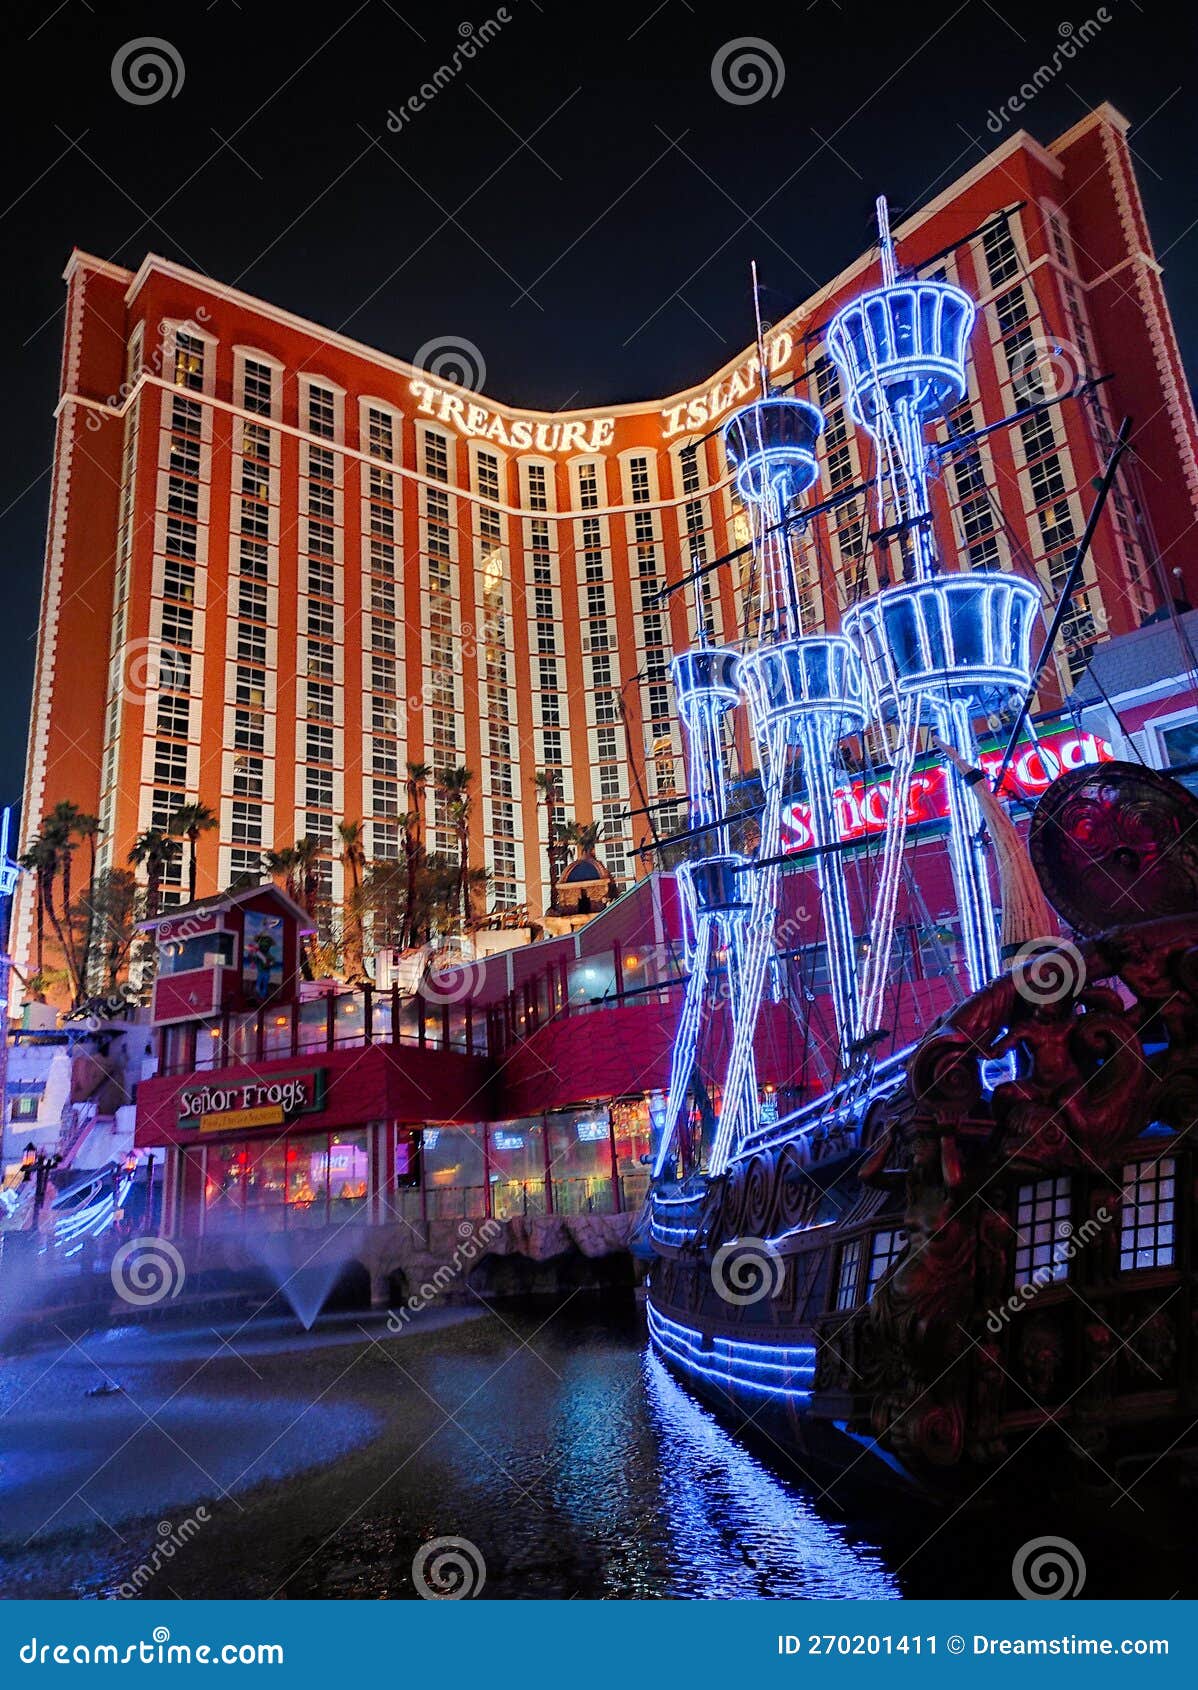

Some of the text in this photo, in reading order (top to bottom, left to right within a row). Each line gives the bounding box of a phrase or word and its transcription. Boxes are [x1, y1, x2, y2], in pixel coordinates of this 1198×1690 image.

[409, 332, 793, 452] TREASURE ISLAND
[781, 778, 931, 853] Sñor
[179, 1086, 238, 1119] Señor
